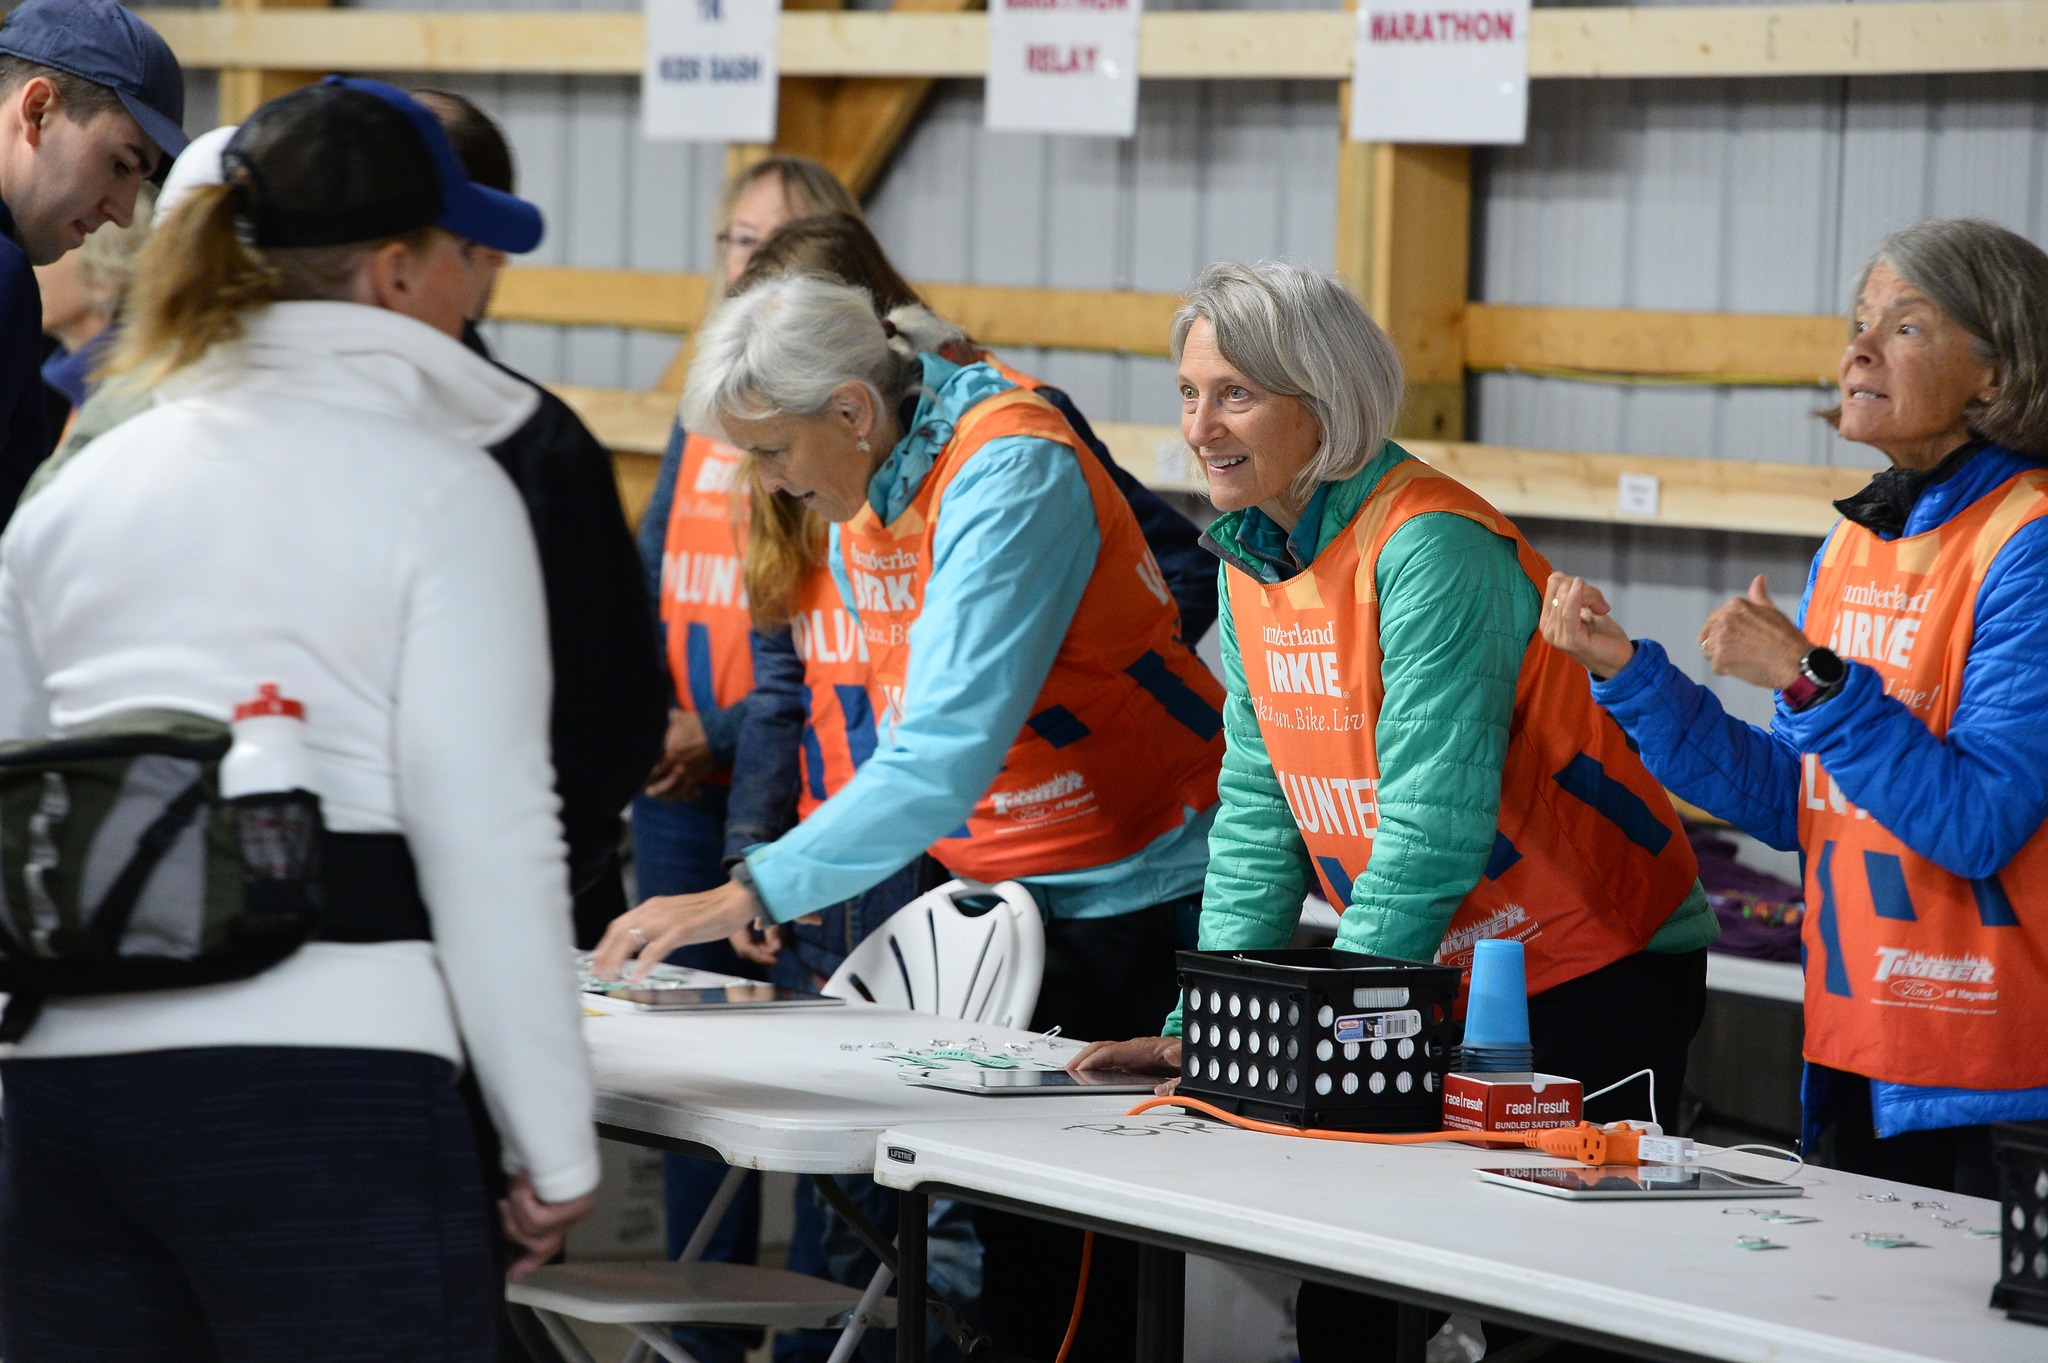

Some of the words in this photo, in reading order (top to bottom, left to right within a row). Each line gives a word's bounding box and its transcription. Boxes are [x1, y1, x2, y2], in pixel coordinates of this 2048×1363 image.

[1370, 11, 1514, 42] MARATHON
[1026, 44, 1098, 72] RELAY
[1294, 706, 1330, 732] Bike.
[1873, 944, 1996, 984] TIMBER
[1495, 1121, 1531, 1130] BUNDLED
[1531, 1120, 1559, 1129] SAFETY
[1560, 1120, 1576, 1128] PINS
[890, 1149, 914, 1161] LIFETIME
